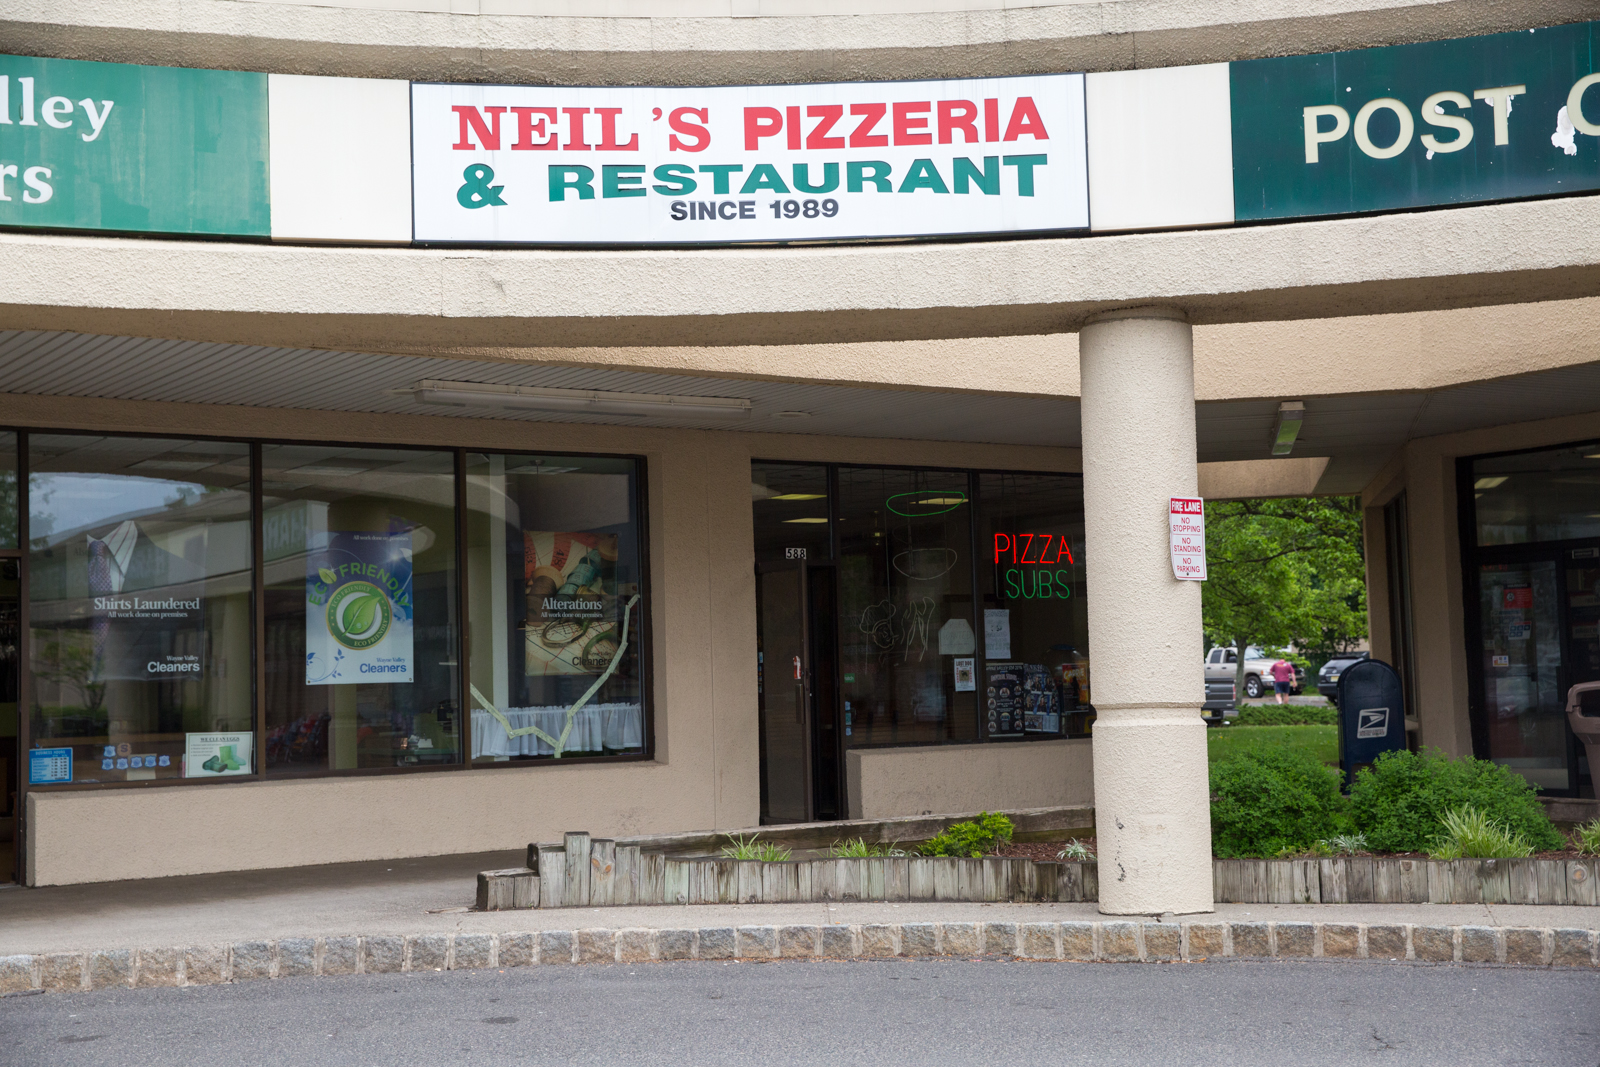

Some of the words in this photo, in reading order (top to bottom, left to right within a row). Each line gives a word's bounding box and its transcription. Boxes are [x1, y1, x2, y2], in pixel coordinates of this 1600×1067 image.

[451, 104, 711, 153] NEIL'S
[743, 96, 1050, 151] PIZZERIA
[1303, 84, 1527, 164] POST
[456, 162, 508, 209] &
[548, 153, 1048, 203] RESTAURANT
[670, 201, 757, 221] SINCE
[768, 199, 840, 219] 1989
[1171, 501, 1183, 512] FIRE
[1184, 502, 1200, 512] LANE
[1173, 525, 1201, 533] STOPPING
[1182, 537, 1191, 545] NO
[786, 549, 806, 559] 588
[994, 533, 1074, 564] PIZZA
[1173, 545, 1201, 553] STANDING
[1182, 557, 1192, 565] NO
[1176, 565, 1200, 573] PARKING
[338, 562, 410, 607] FRIENDLY
[1006, 569, 1070, 599] SUBS
[342, 584, 371, 599] FRIENDLY
[94, 597, 132, 610] Shirts
[133, 597, 200, 610] Laundered
[541, 597, 602, 610] Alterations
[160, 611, 188, 620] premises
[581, 611, 604, 619] premises
[354, 639, 367, 648] ECO
[367, 619, 389, 645] FRIENDLY
[392, 656, 406, 664] Valley
[572, 656, 613, 666] Cleaners
[147, 661, 201, 673] Cleaners
[360, 663, 407, 674] Cleaners
